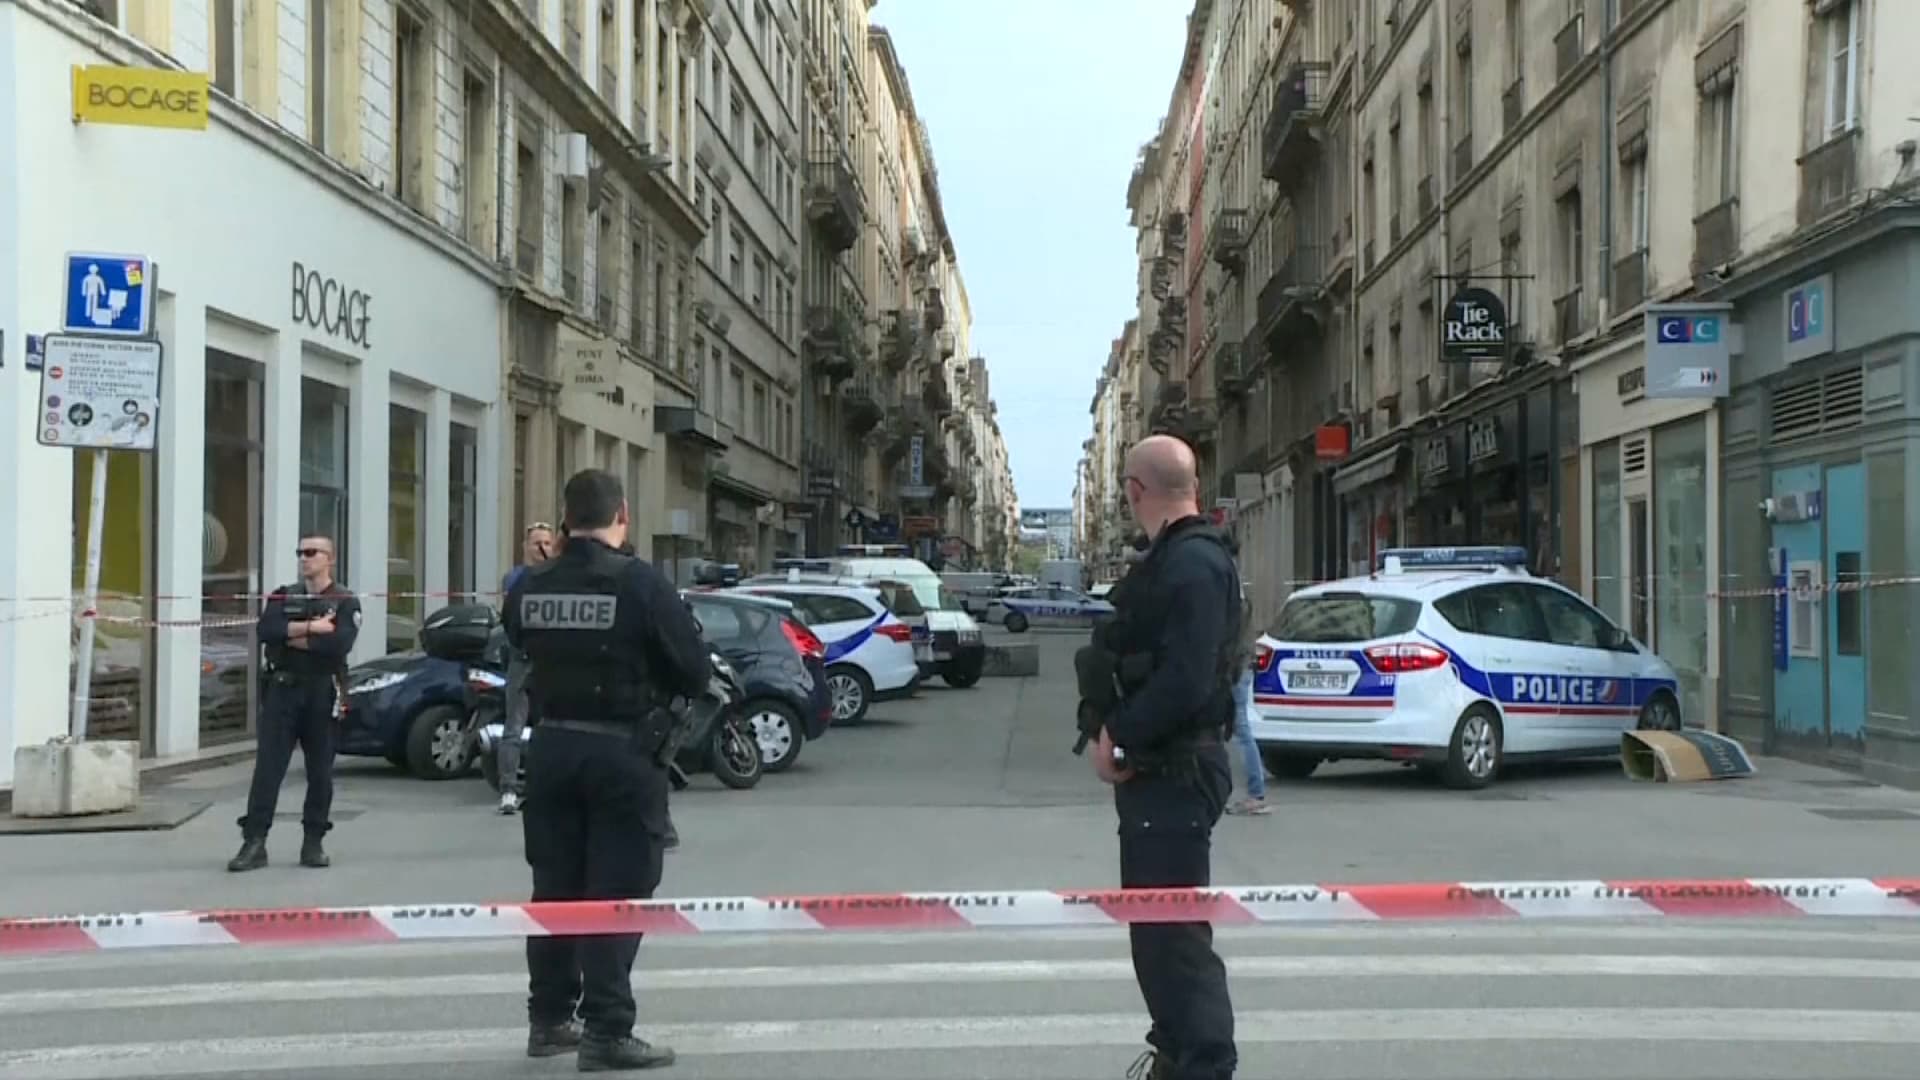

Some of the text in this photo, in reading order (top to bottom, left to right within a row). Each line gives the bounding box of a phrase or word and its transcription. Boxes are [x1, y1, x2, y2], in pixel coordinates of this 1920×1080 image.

[88, 83, 200, 113] BOCAGE
[292, 261, 372, 349] BOCAGE
[1456, 301, 1489, 325] Tie
[1791, 294, 1818, 332] CIC
[1447, 321, 1504, 341] Rack
[1663, 320, 1713, 340] CIC
[911, 438, 921, 484] HOTEL
[525, 600, 611, 623] POLICE
[1294, 649, 1335, 659] POLICE
[1512, 676, 1593, 702] POLICE
